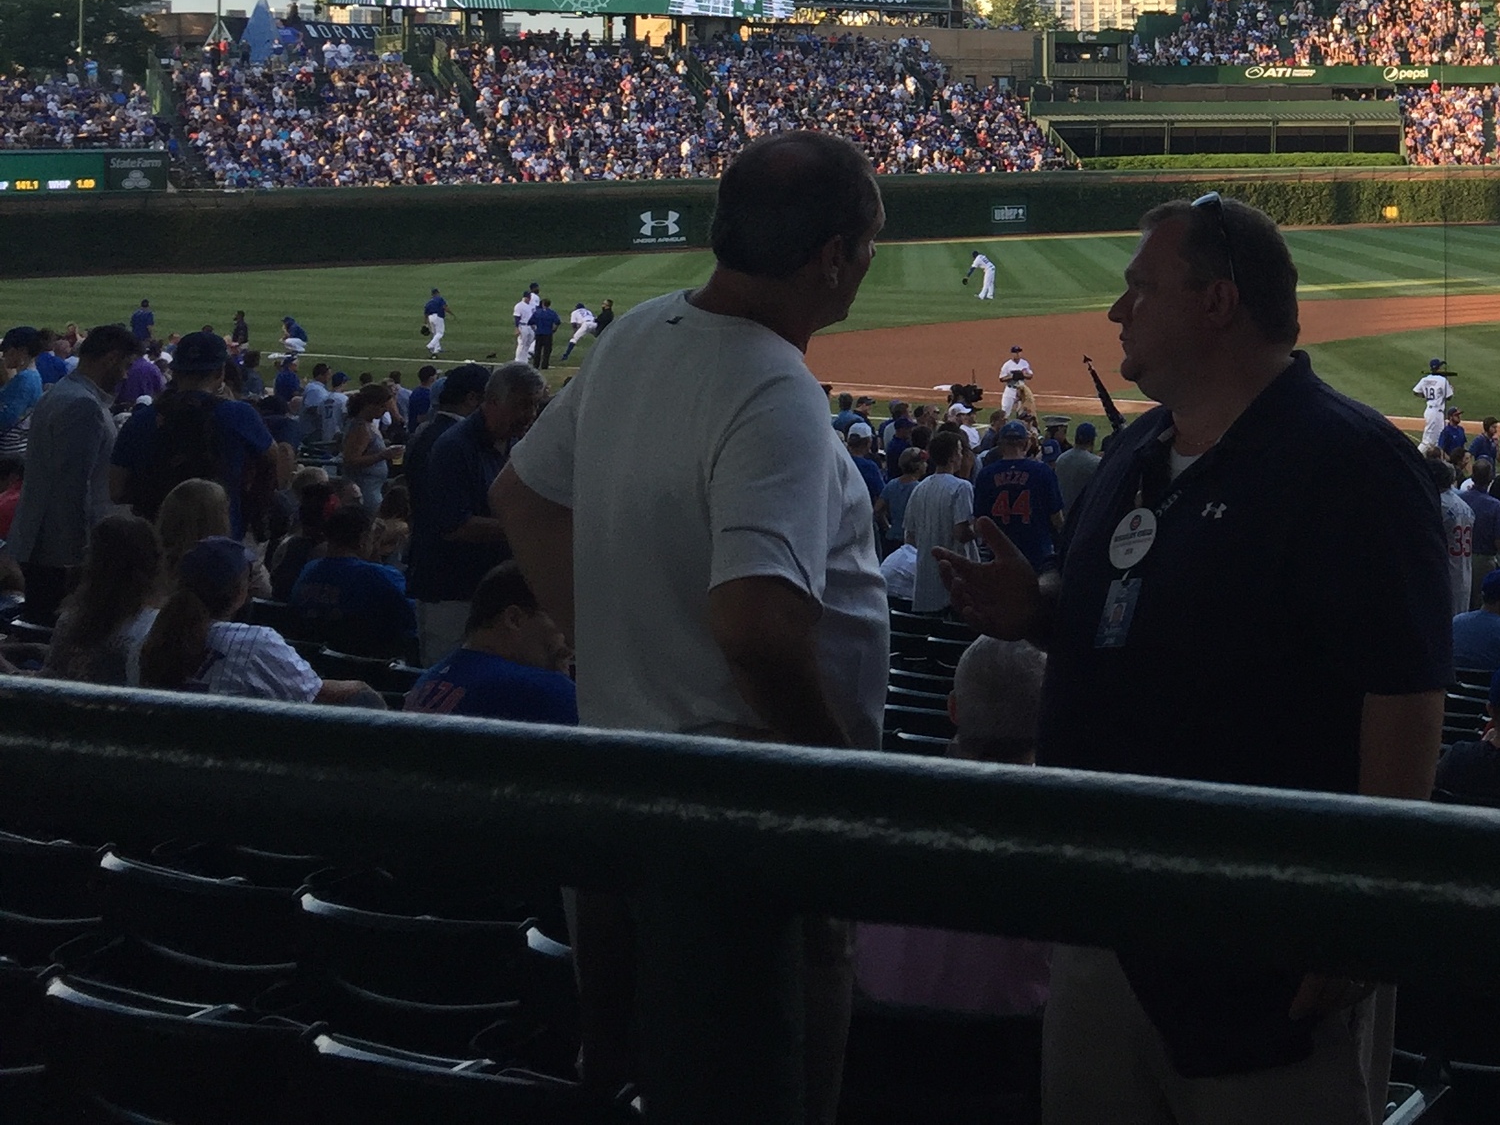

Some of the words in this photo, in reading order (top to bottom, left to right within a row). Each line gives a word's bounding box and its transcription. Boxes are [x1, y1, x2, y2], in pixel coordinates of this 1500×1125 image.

[1262, 67, 1292, 77] ATI
[1398, 67, 1429, 80] pepsi
[993, 470, 1030, 487] RIZZO
[991, 489, 1031, 526] 44
[1448, 525, 1473, 558] 33
